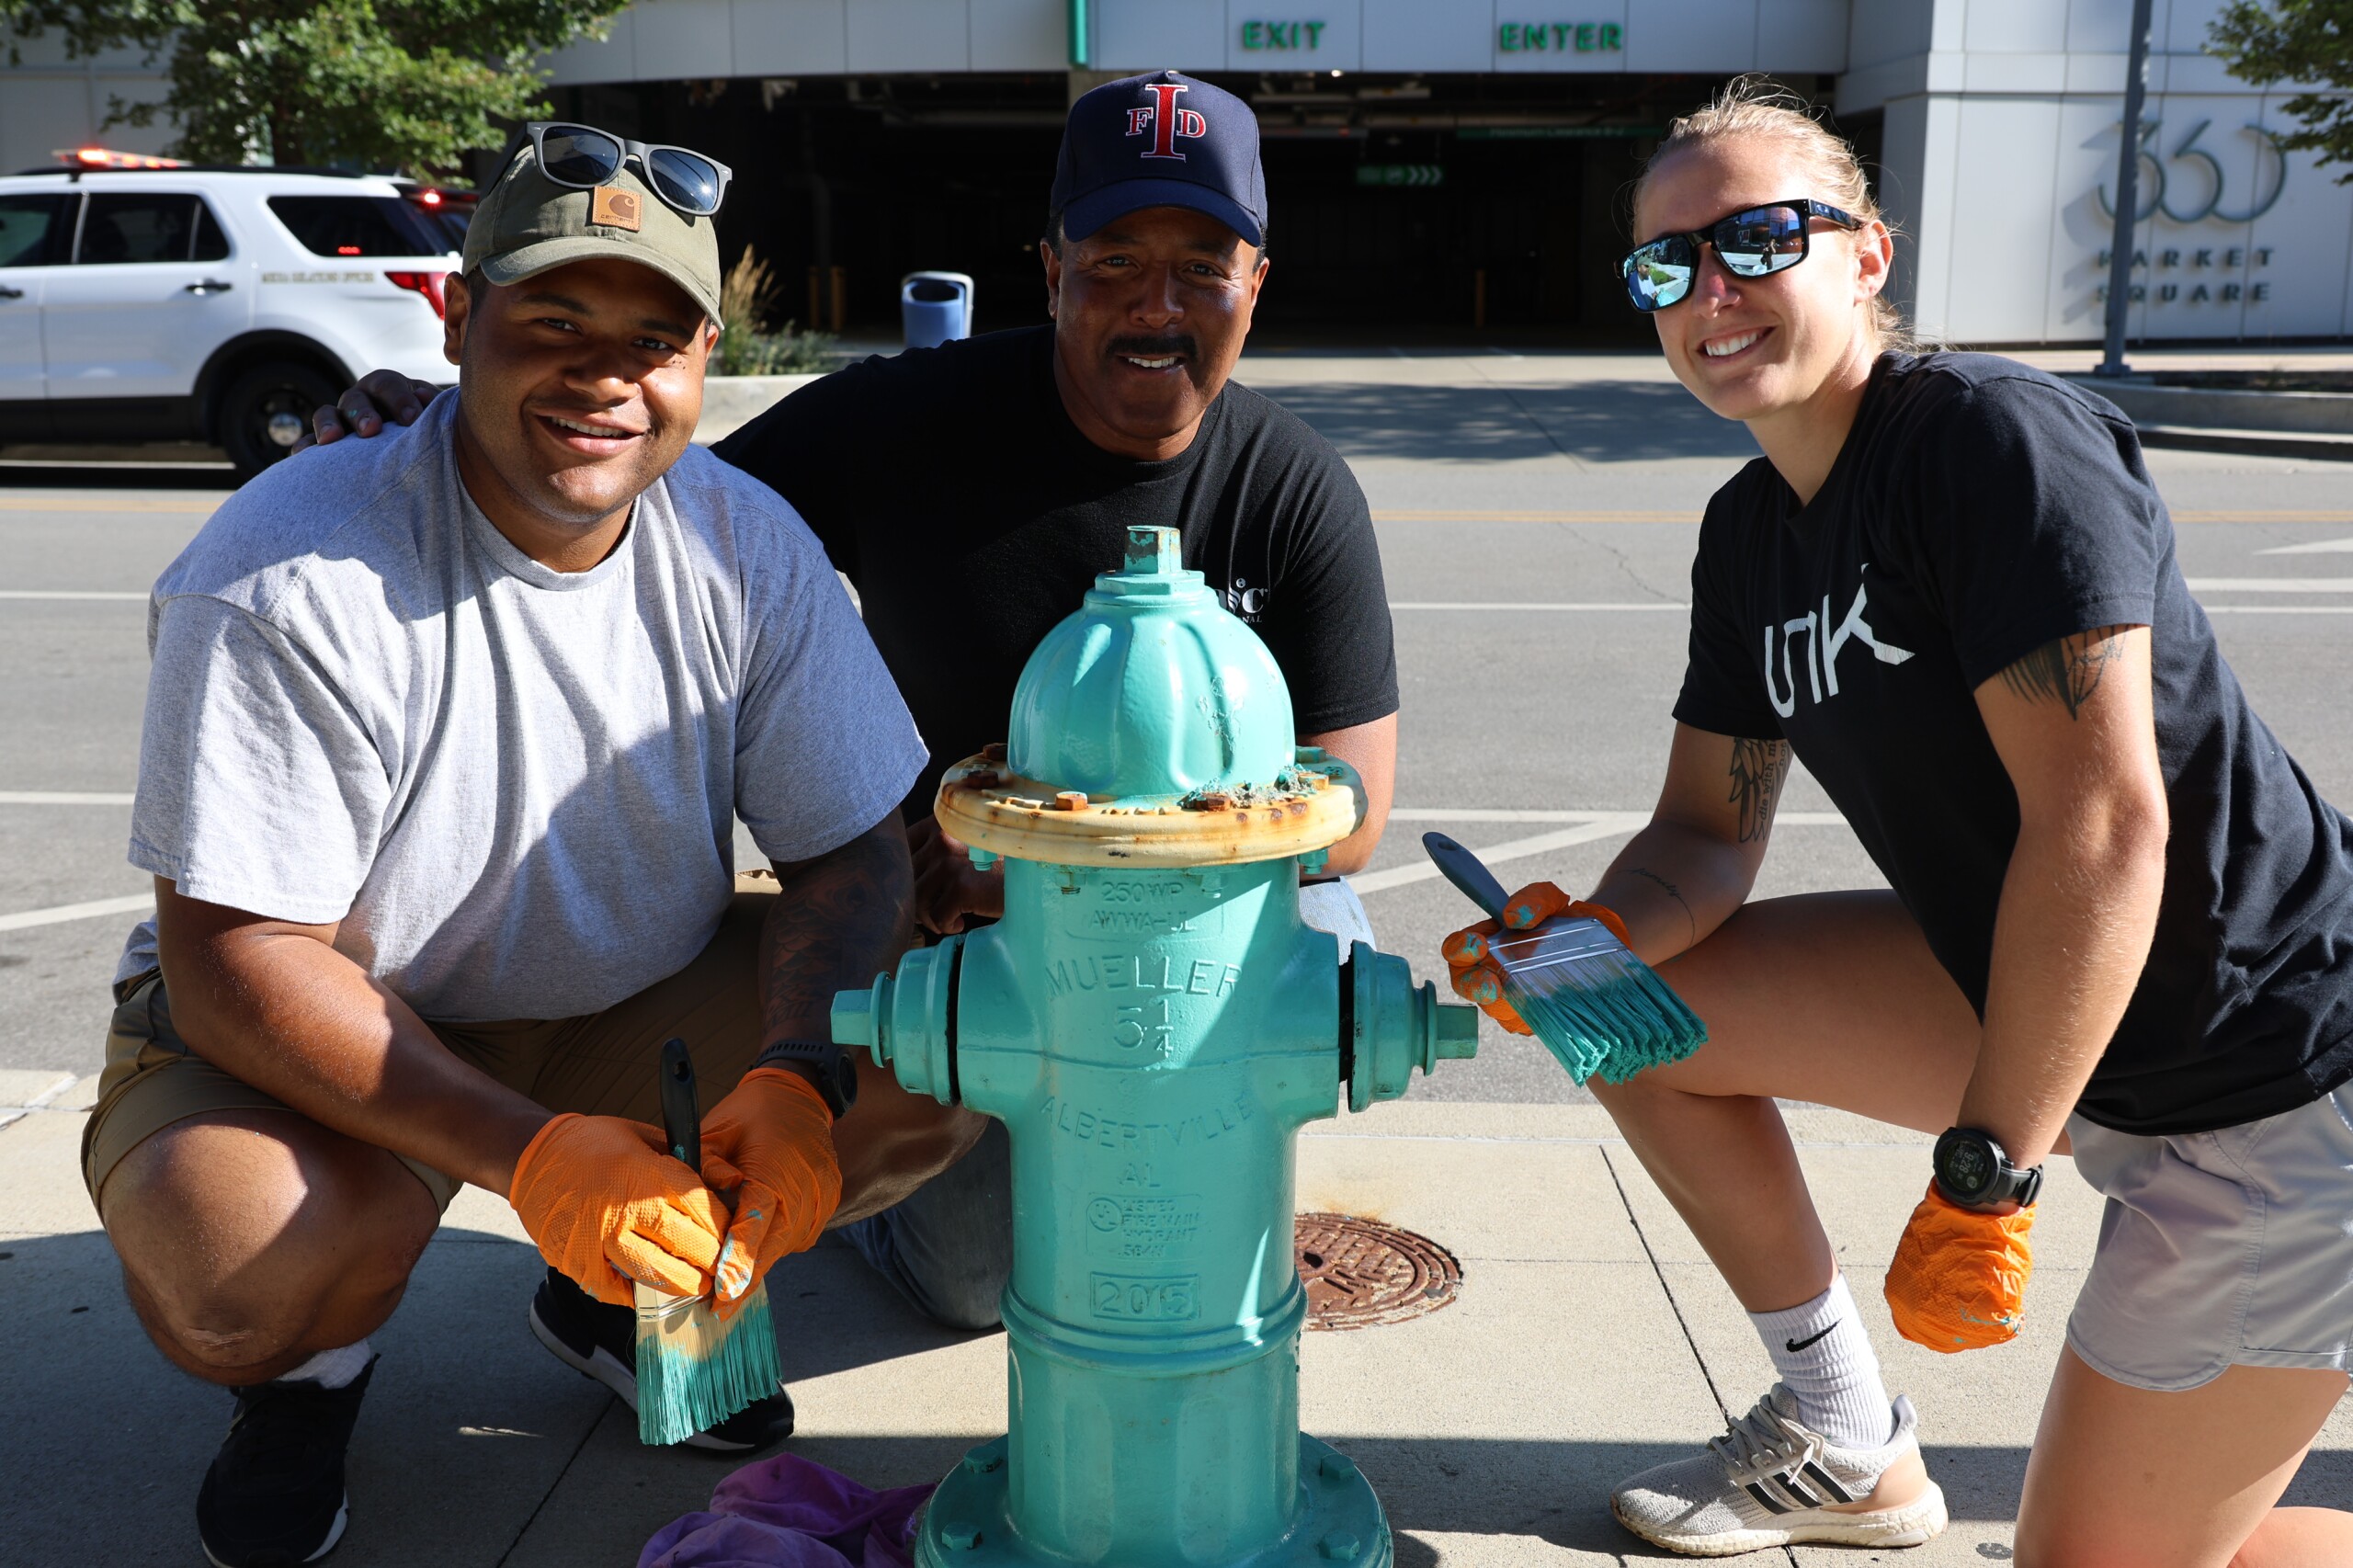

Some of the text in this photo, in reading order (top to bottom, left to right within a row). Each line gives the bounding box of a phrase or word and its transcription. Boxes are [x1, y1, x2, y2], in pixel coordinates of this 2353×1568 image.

[1243, 21, 1326, 50] EXIT
[1499, 23, 1623, 51] ENTER
[1045, 955, 1242, 996] MUELLER
[1040, 1095, 1254, 1150] ALBERTVILLE
[1120, 1162, 1161, 1187] AL
